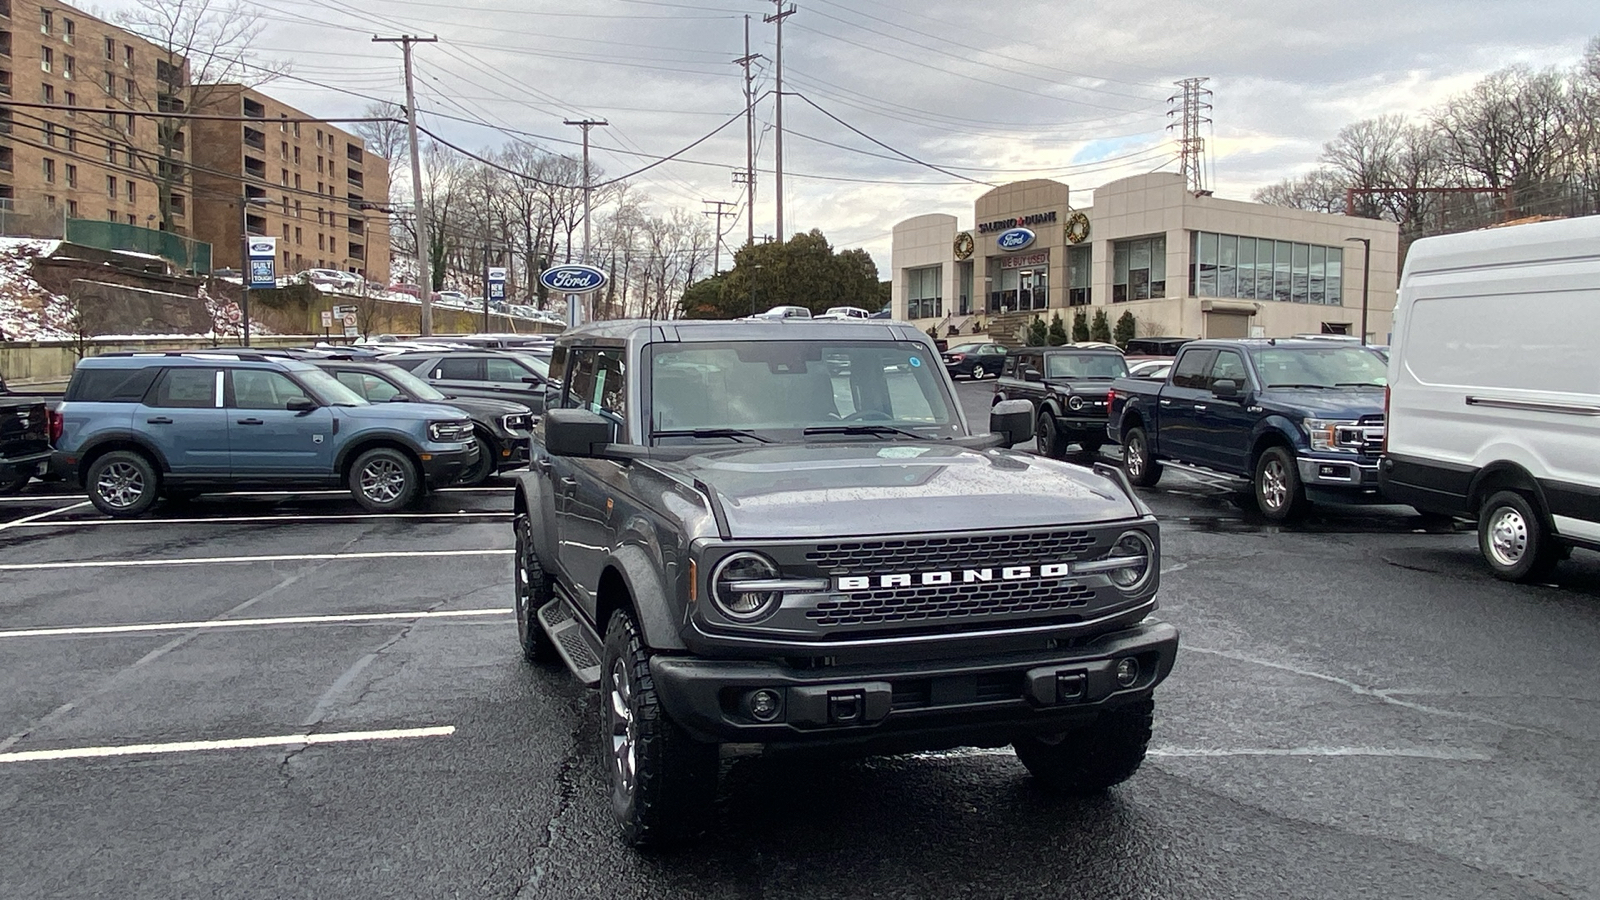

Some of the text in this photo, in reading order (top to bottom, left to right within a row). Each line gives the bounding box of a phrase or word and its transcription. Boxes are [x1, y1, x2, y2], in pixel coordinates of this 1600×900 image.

[1025, 211, 1057, 225] DUANE
[1003, 232, 1025, 246] Ford
[1013, 256, 1028, 266] BUY
[1029, 254, 1046, 265] USED
[553, 270, 592, 287] Ford
[838, 563, 1068, 591] BRONCO
